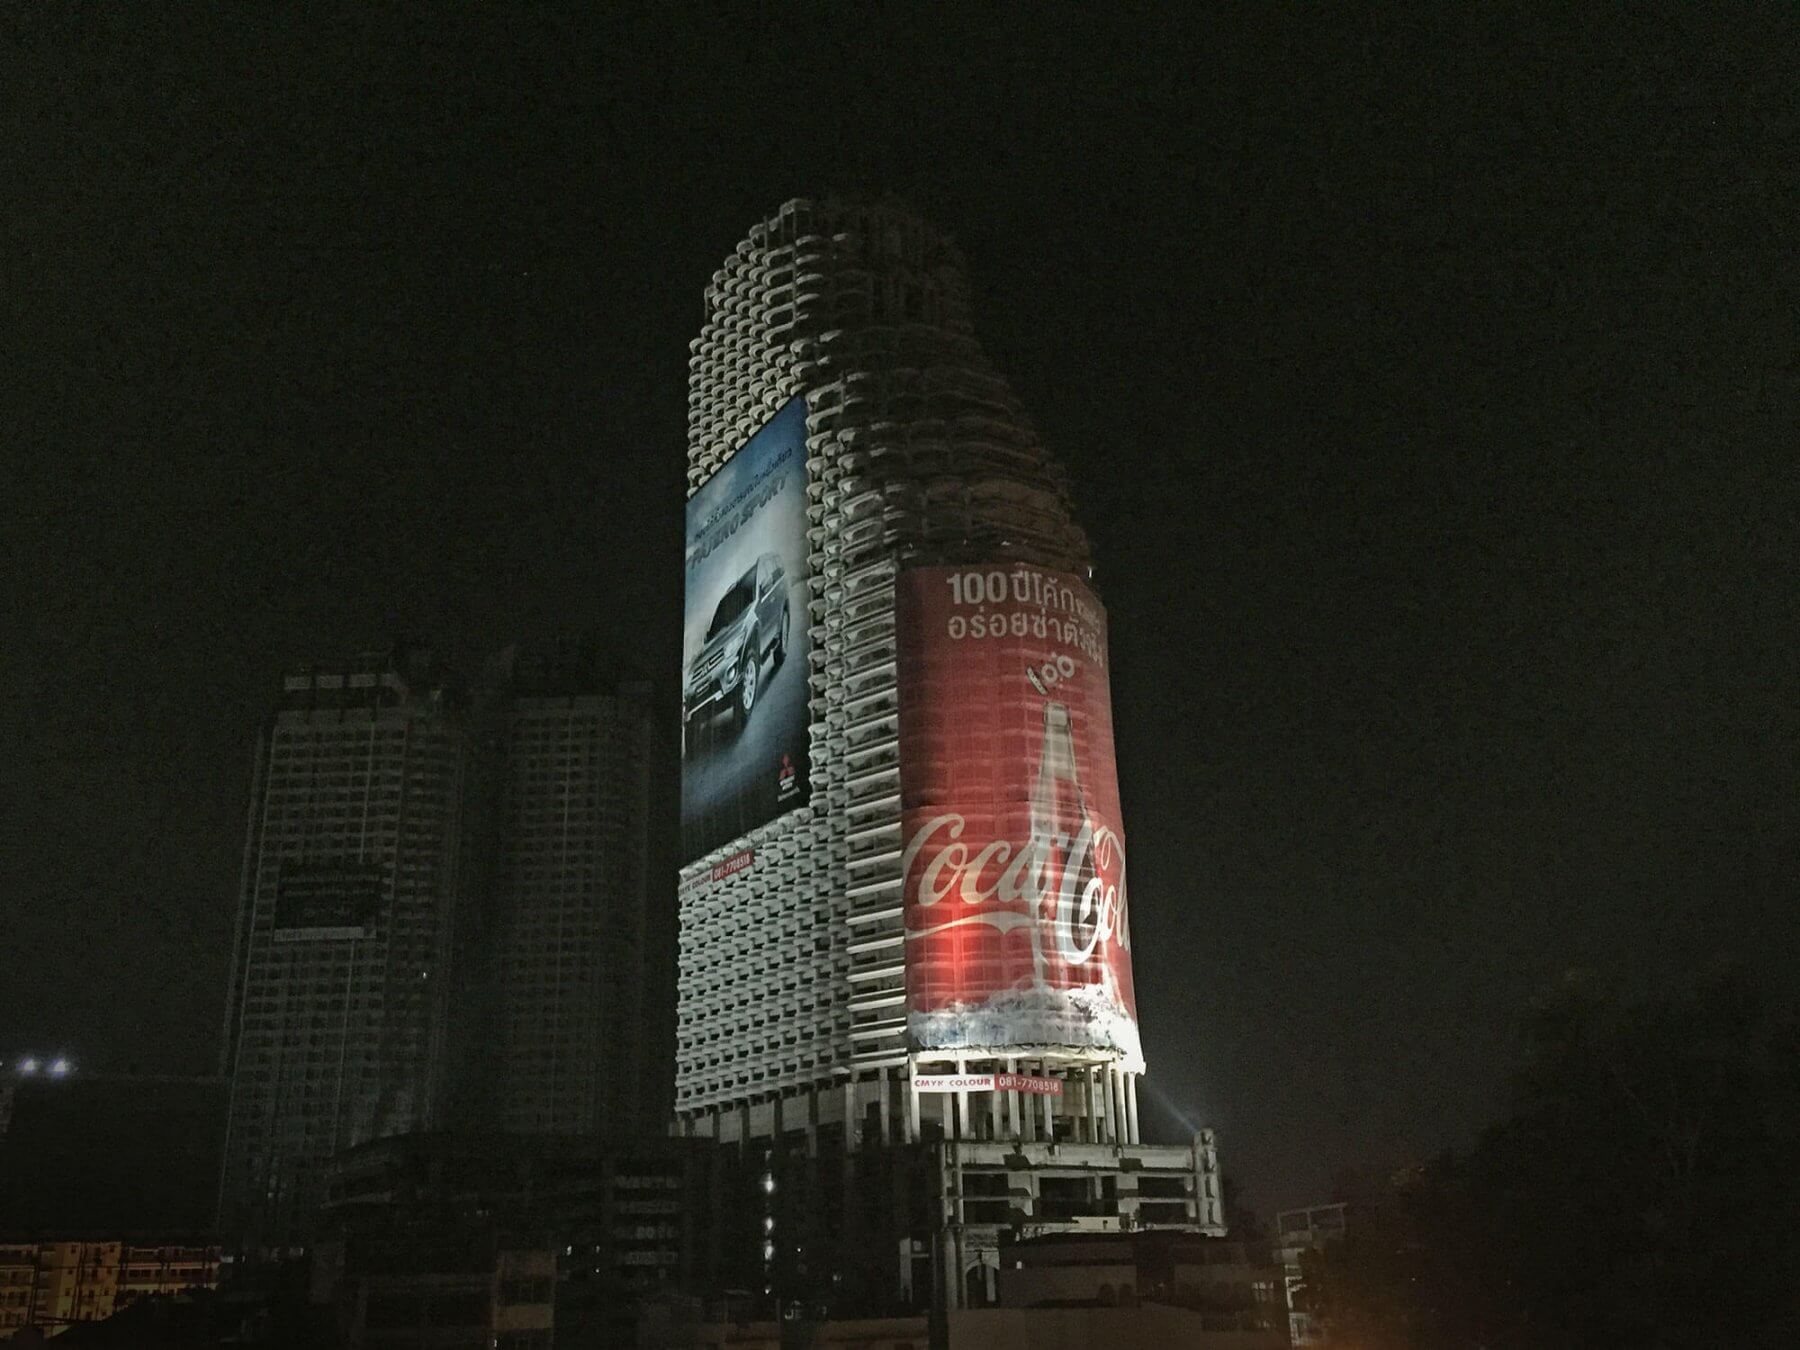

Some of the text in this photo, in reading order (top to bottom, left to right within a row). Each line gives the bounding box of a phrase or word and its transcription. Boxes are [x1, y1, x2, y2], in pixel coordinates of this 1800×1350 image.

[914, 1076, 1059, 1092] CMYK COLOUR 081-7708518
